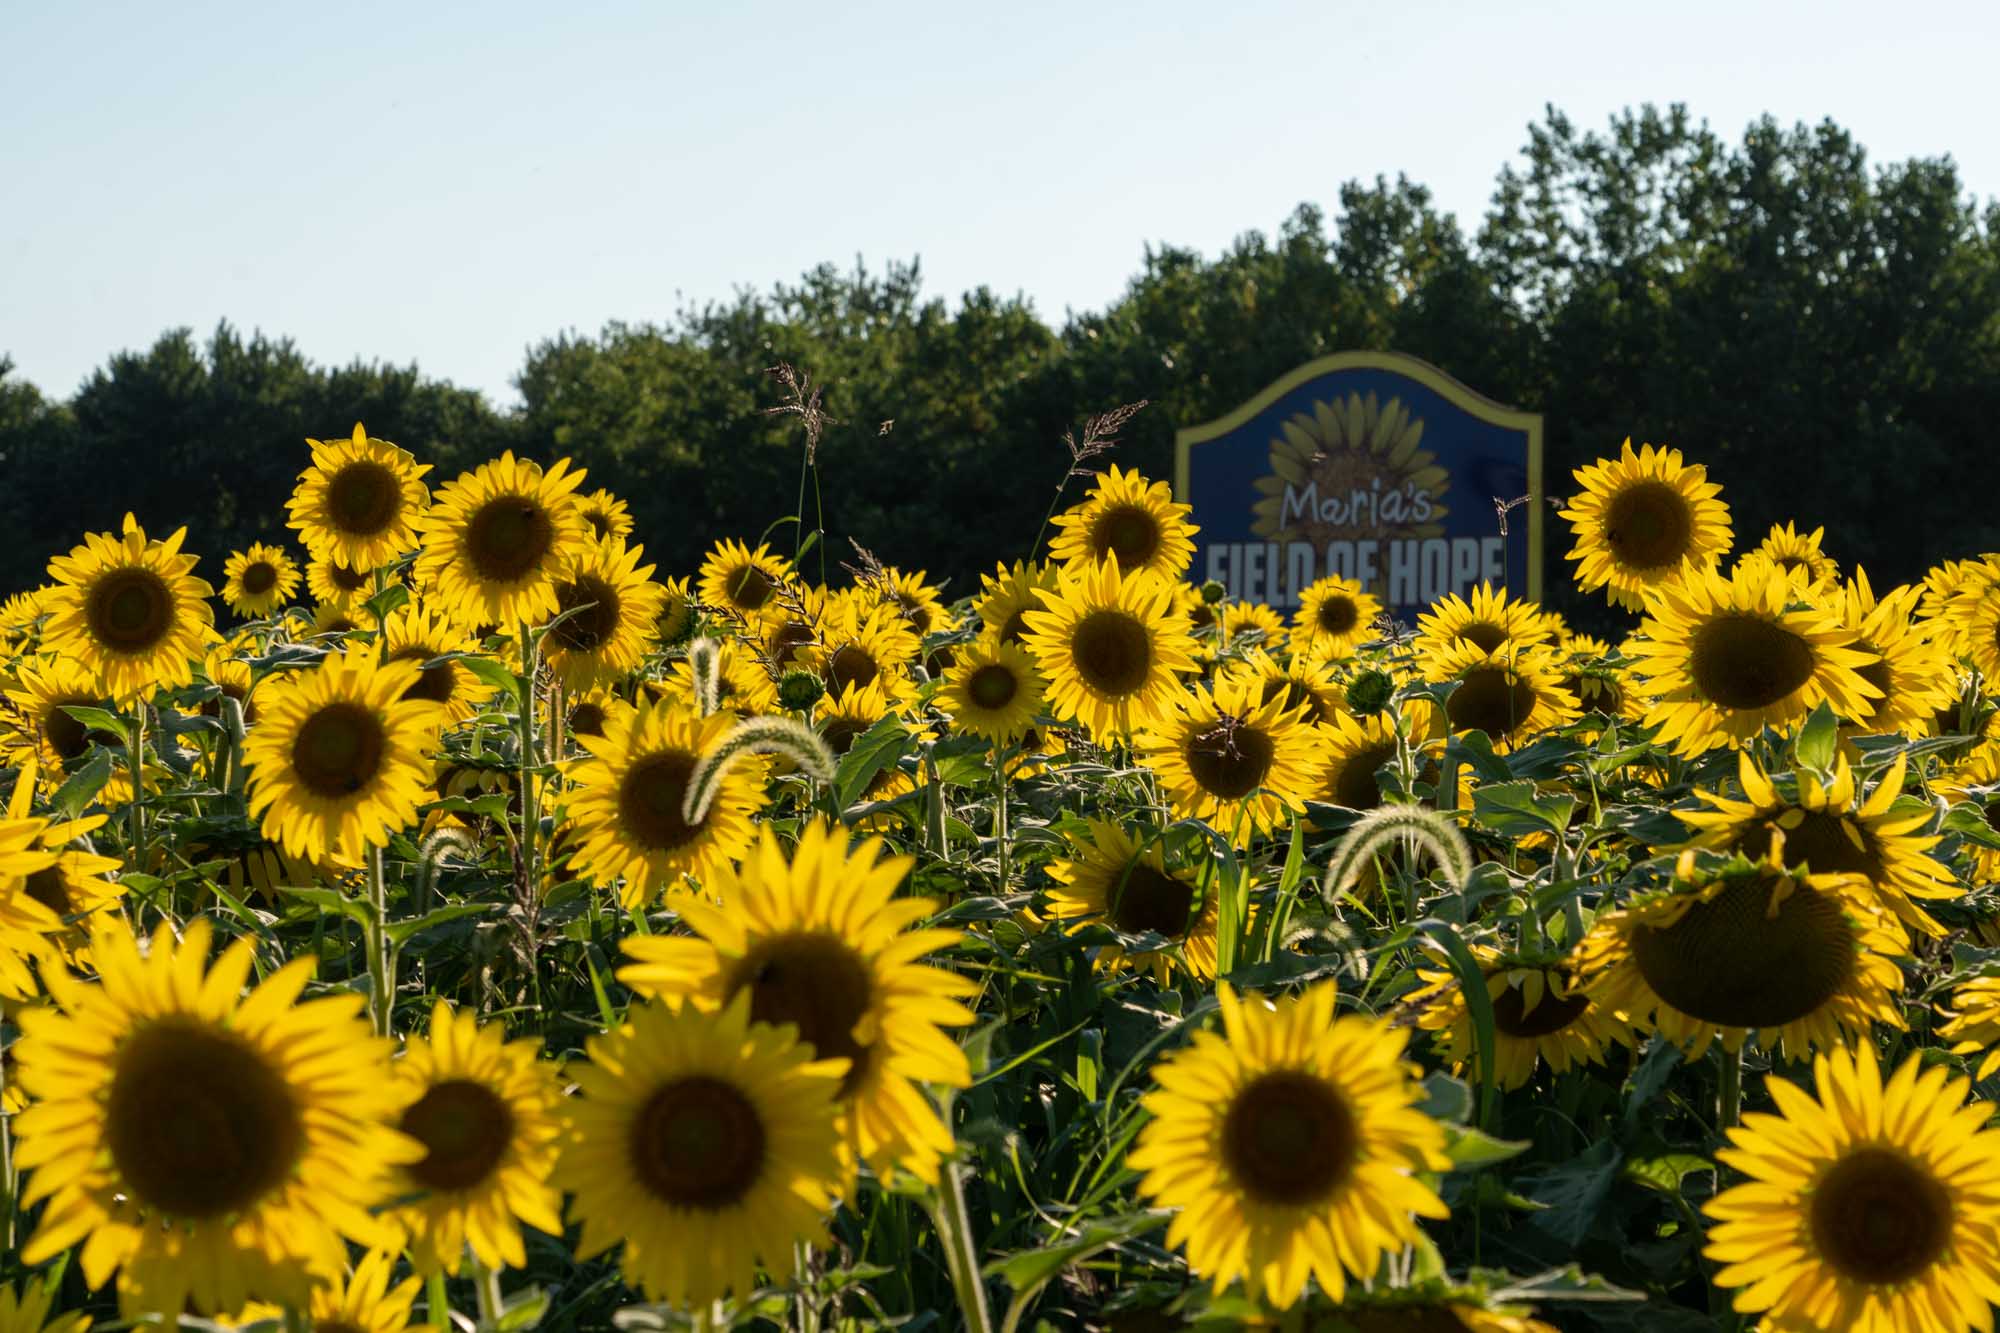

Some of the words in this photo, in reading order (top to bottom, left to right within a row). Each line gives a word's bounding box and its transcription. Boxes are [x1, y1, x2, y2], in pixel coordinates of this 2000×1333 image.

[1281, 477, 1433, 530] Maria's
[1208, 543, 1315, 606] FIELD
[1390, 537, 1505, 605] HOPE
